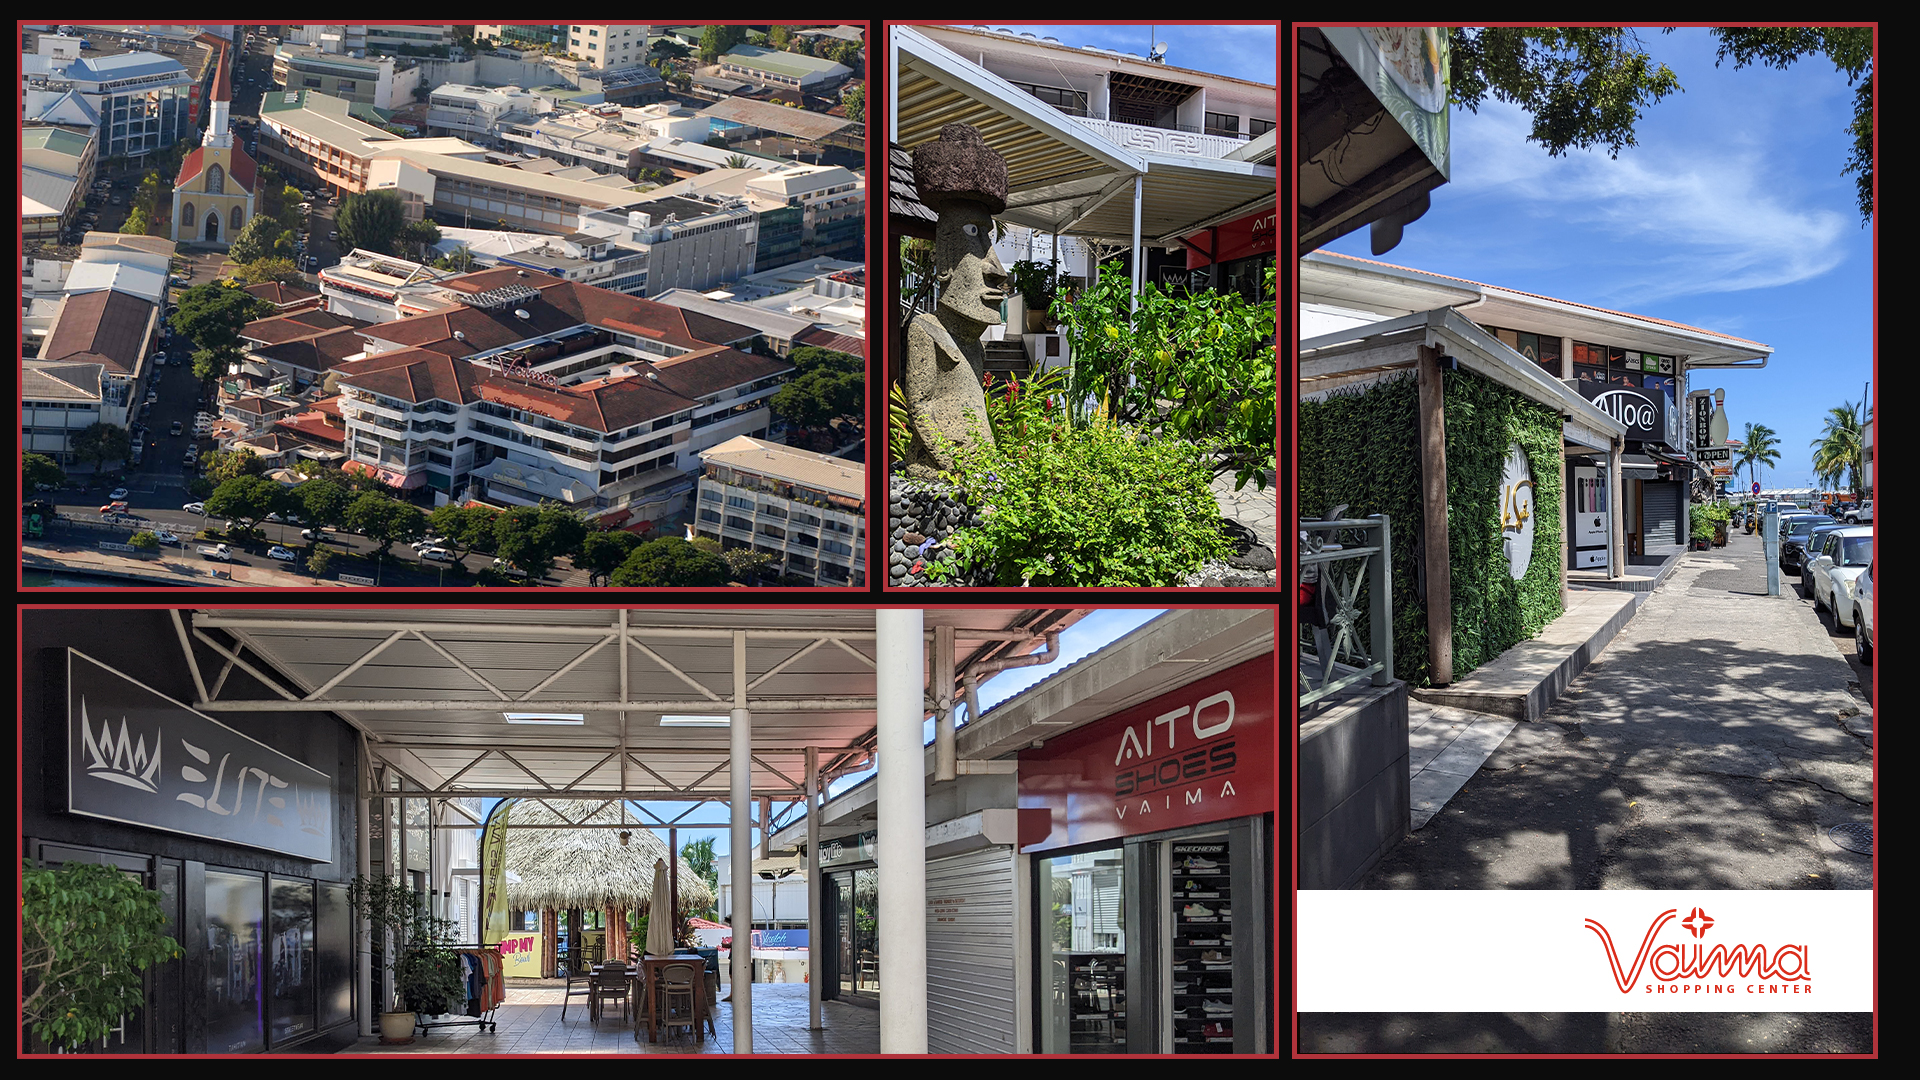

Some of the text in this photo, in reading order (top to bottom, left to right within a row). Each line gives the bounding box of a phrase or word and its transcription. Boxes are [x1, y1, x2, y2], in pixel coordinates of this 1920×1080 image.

[1769, 502, 1776, 512] P
[1115, 690, 1236, 766] AITO
[176, 738, 289, 828] ELITE
[1115, 741, 1237, 797] SHOES
[1116, 780, 1236, 820] VAIMA
[1174, 845, 1224, 853] SKECHERS
[519, 936, 535, 953] MY
